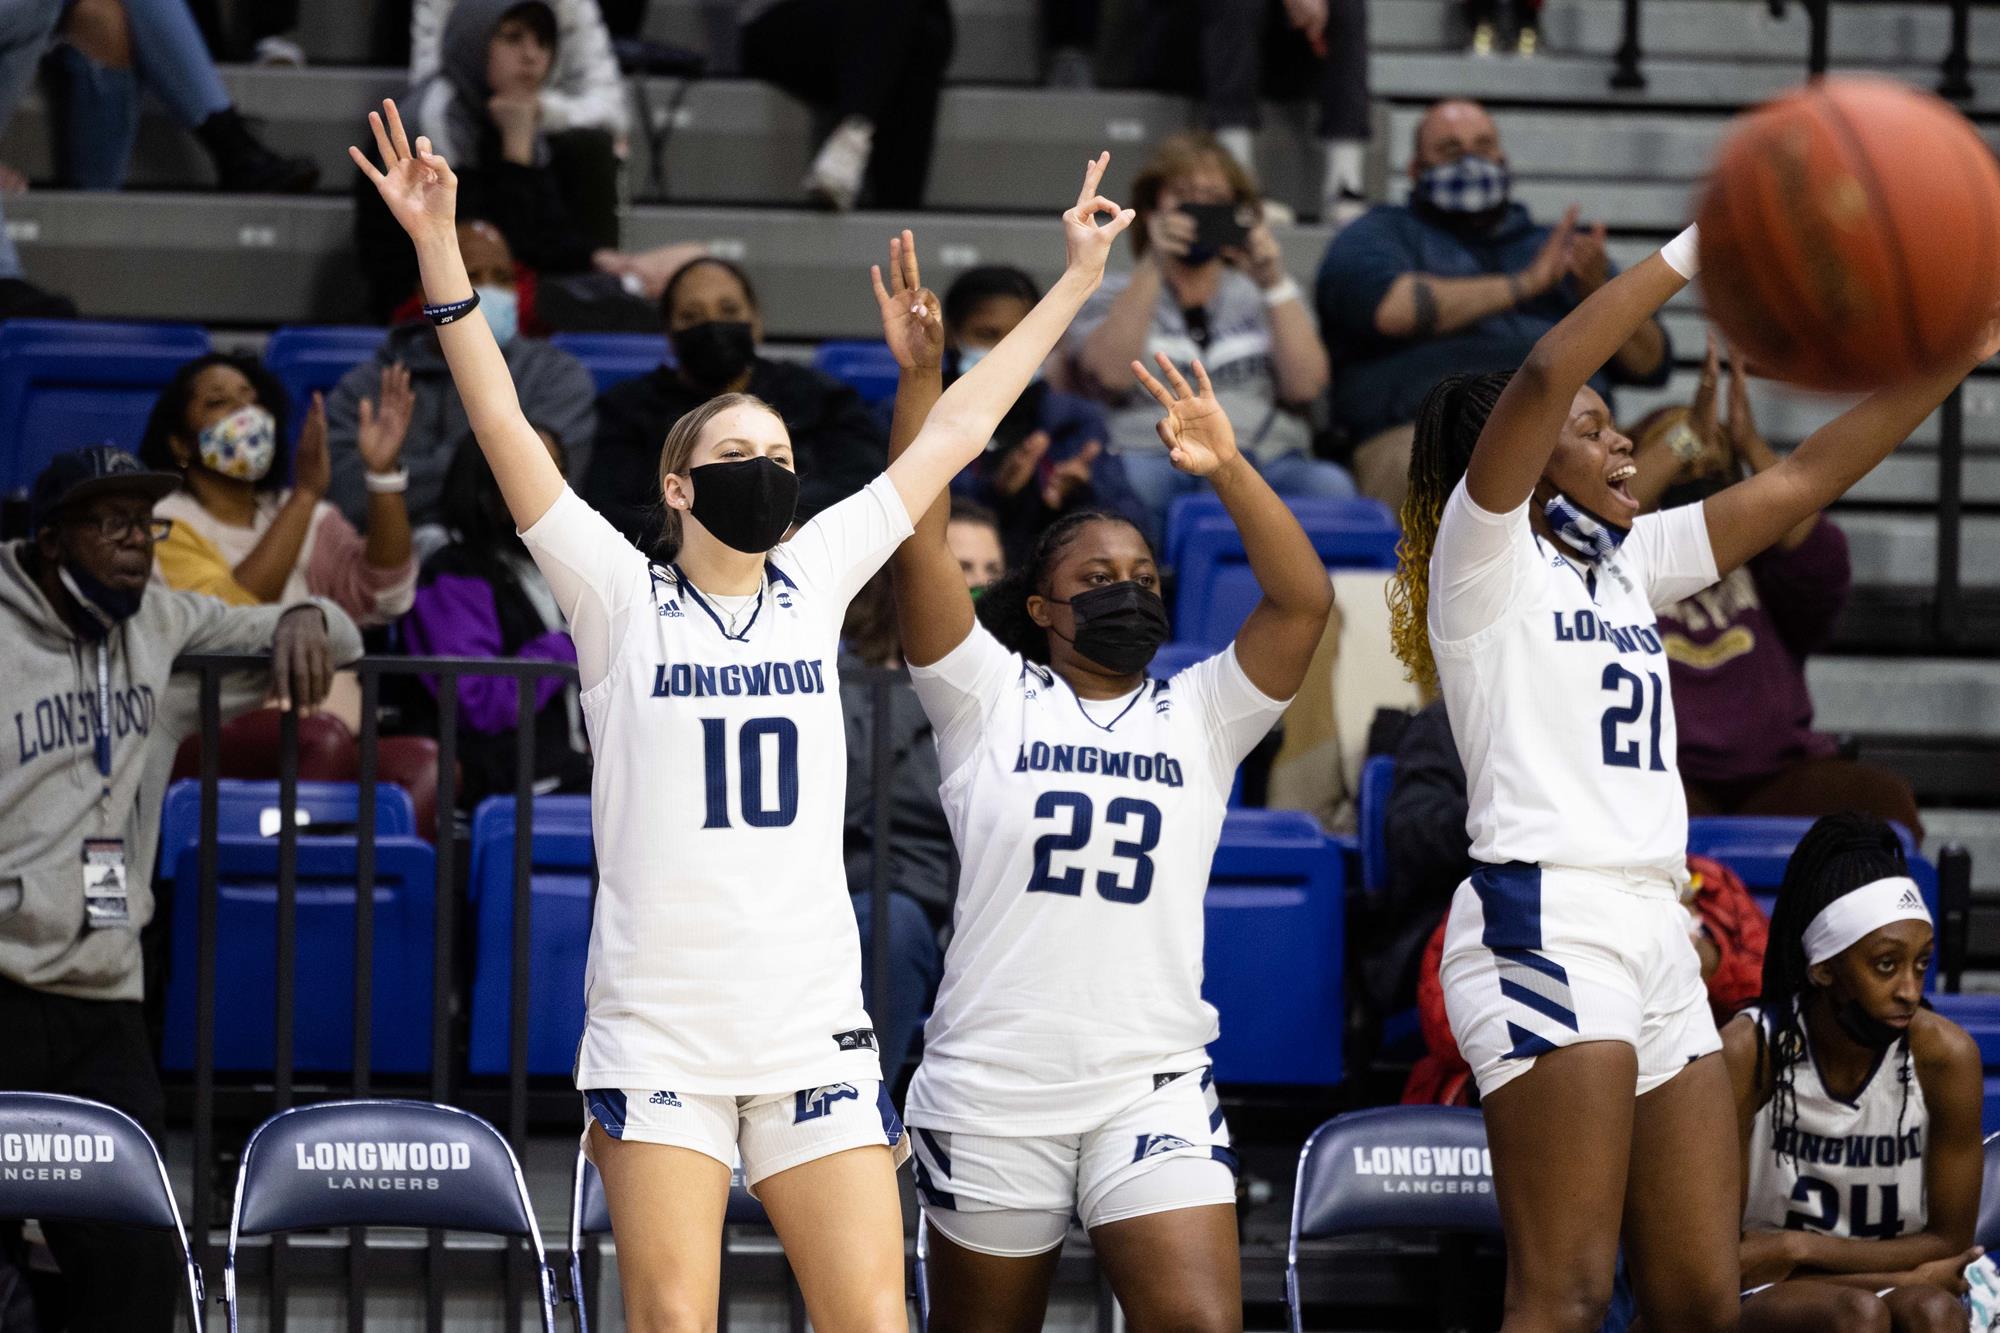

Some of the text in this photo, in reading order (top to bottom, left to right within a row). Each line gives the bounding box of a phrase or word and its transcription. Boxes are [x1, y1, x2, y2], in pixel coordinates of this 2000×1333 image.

[441, 315, 454, 324] JOY
[650, 659, 825, 698] LONGWOOD
[1600, 662, 1668, 772] 21
[698, 716, 799, 831] 10
[1012, 740, 1184, 787] LONGWOOD
[1026, 790, 1163, 905] 23
[649, 1096, 683, 1108] adidas
[0, 1133, 115, 1162] GWOOD
[296, 1141, 471, 1171] LONGWOOD
[0, 1168, 83, 1180] NCERS
[328, 1177, 440, 1191] LANCERS
[1383, 1180, 1492, 1194] LANCERS
[1783, 1175, 1905, 1241] 24
